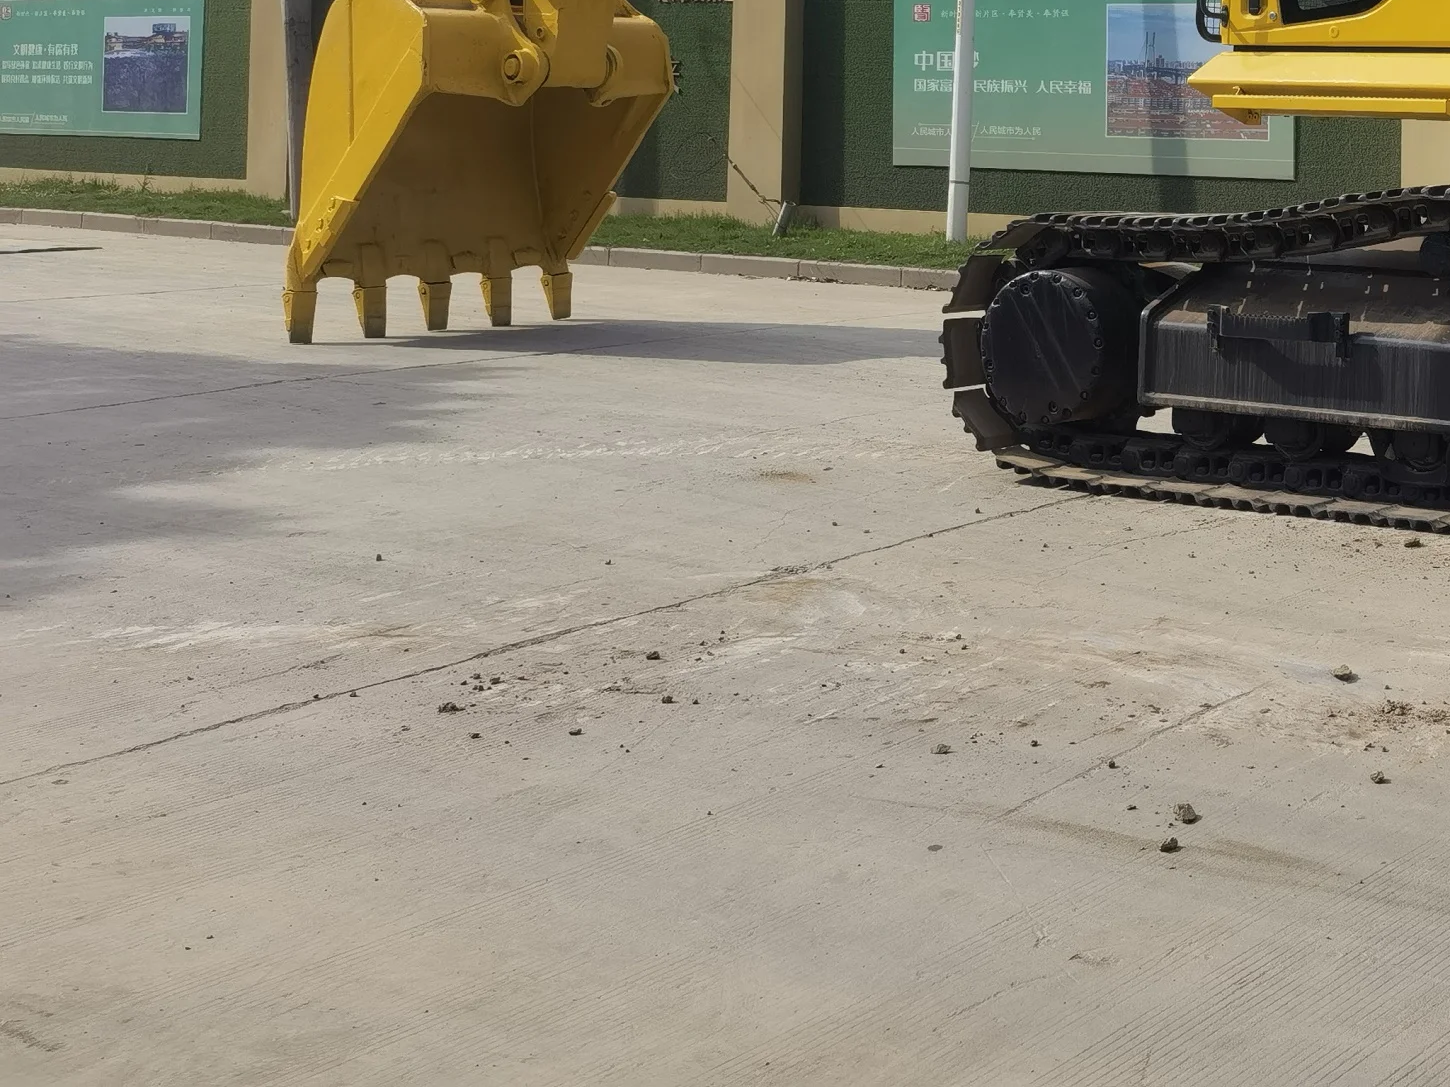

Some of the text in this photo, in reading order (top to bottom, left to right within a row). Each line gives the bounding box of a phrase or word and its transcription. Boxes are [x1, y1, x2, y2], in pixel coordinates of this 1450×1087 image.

[914, 50, 980, 72] 中国
[914, 78, 953, 93] 国家富
[1035, 80, 1092, 95] 人民幸福
[980, 125, 1042, 137] 人民城市为人民
